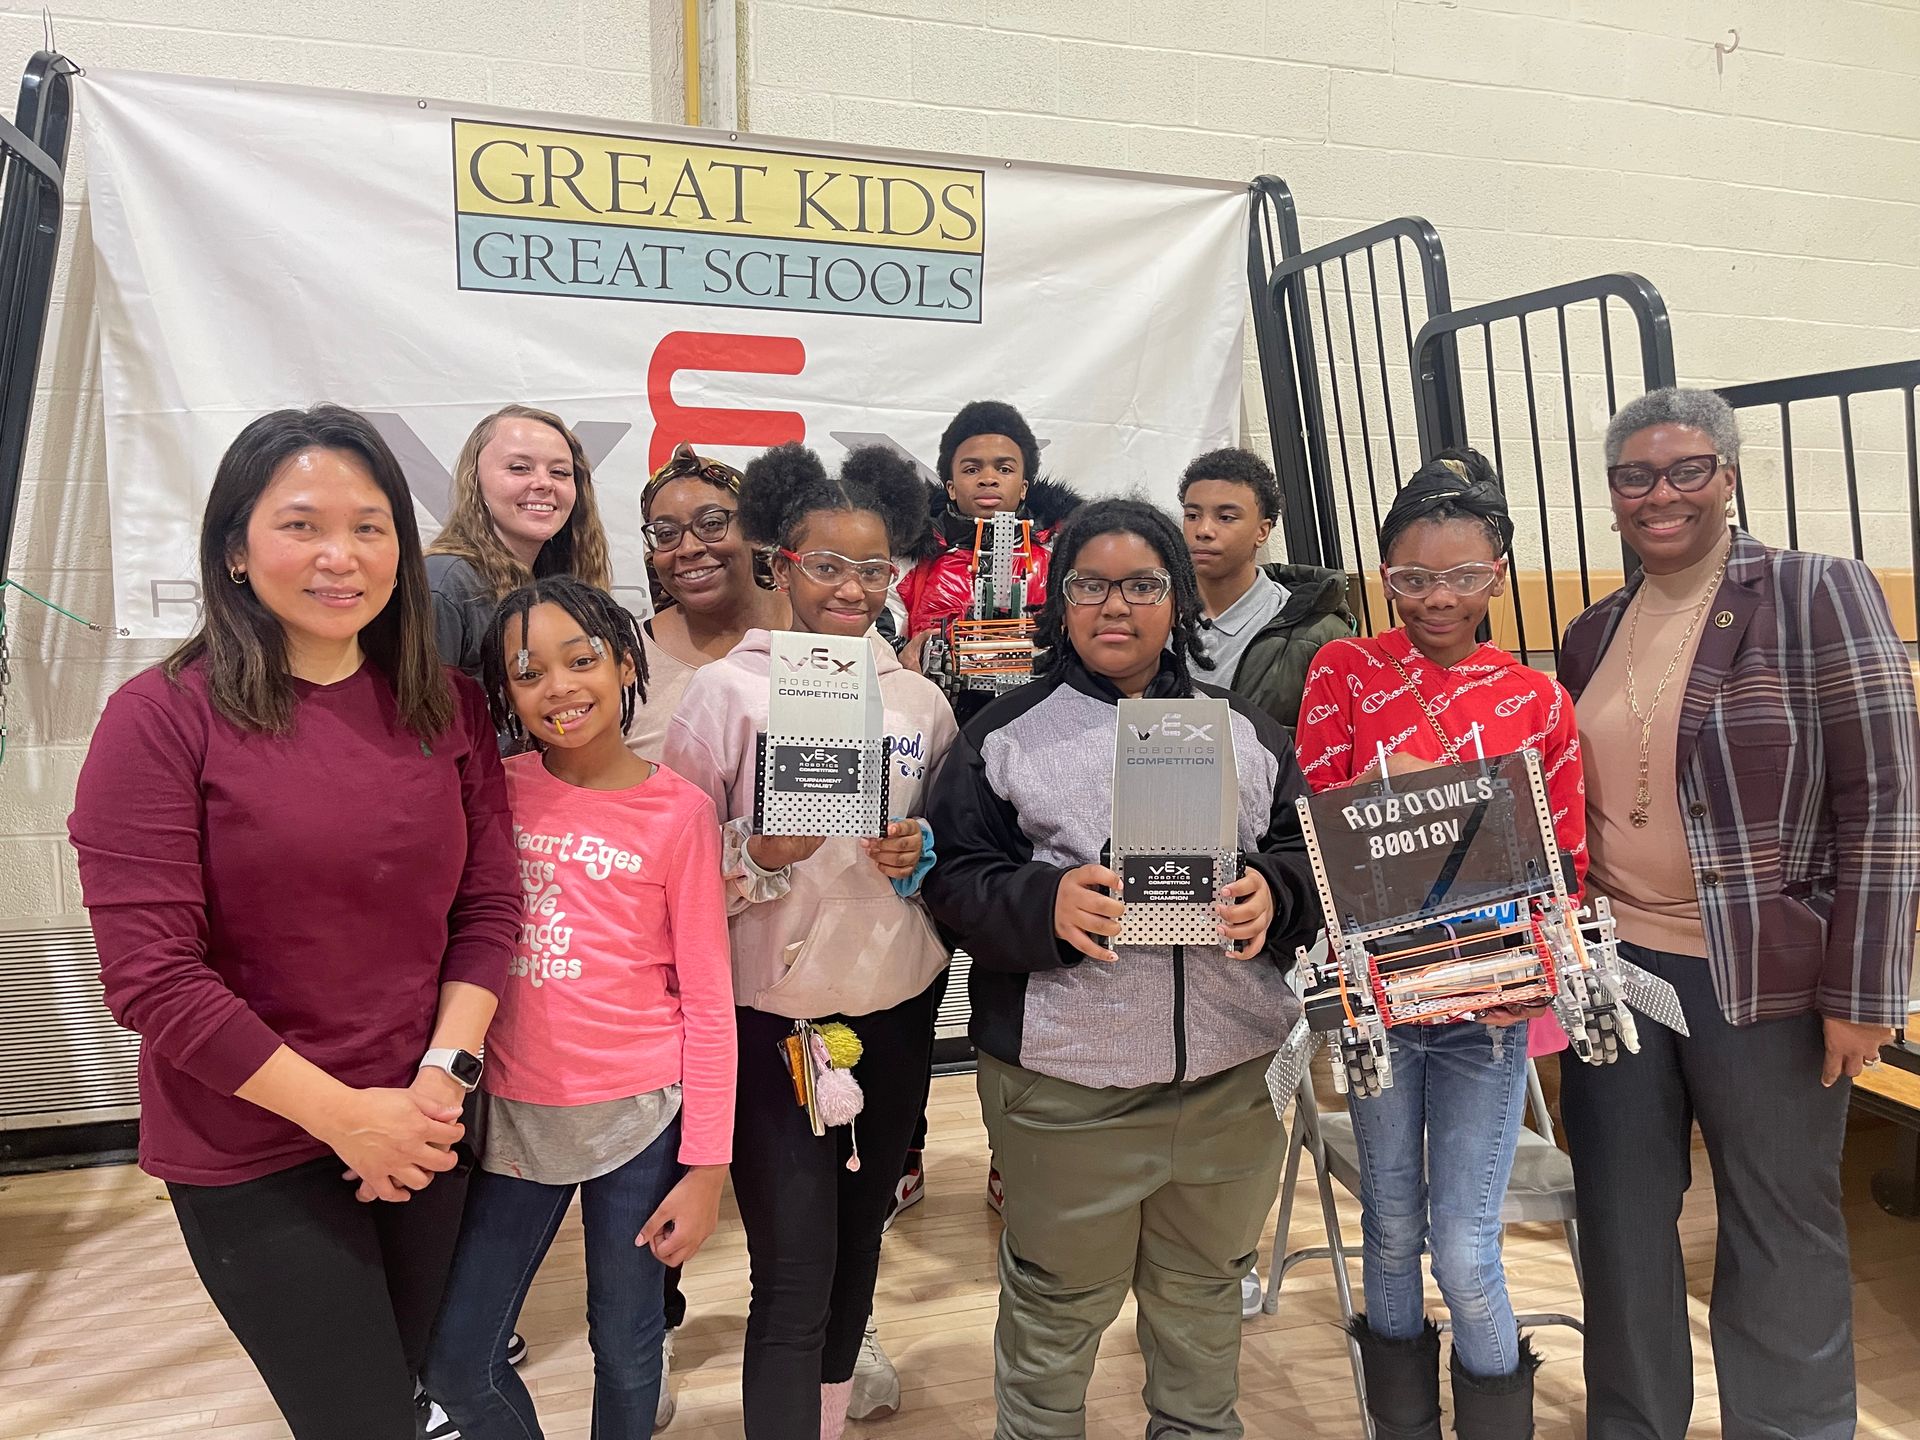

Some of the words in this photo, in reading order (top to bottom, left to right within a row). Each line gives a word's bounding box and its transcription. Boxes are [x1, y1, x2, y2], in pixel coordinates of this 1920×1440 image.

[468, 138, 768, 225] GREAT
[793, 168, 979, 242] KIDS
[472, 231, 686, 291] GREAT
[702, 248, 975, 312] SCHOOLS
[780, 647, 858, 676] VEX
[778, 677, 860, 690] ROBOTICS
[778, 688, 859, 700] COMPETITION
[1127, 712, 1215, 741] VEX
[800, 748, 839, 763] VEX
[886, 732, 924, 761] ood
[1127, 746, 1215, 754] ROBOTICS
[1127, 757, 1215, 765] COMPETITION
[1369, 818, 1460, 859] 80018V
[572, 836, 643, 880] Eyes
[1149, 861, 1190, 876] VEX
[523, 884, 562, 916] ve
[518, 912, 574, 955] ndy
[508, 952, 582, 988] esties
